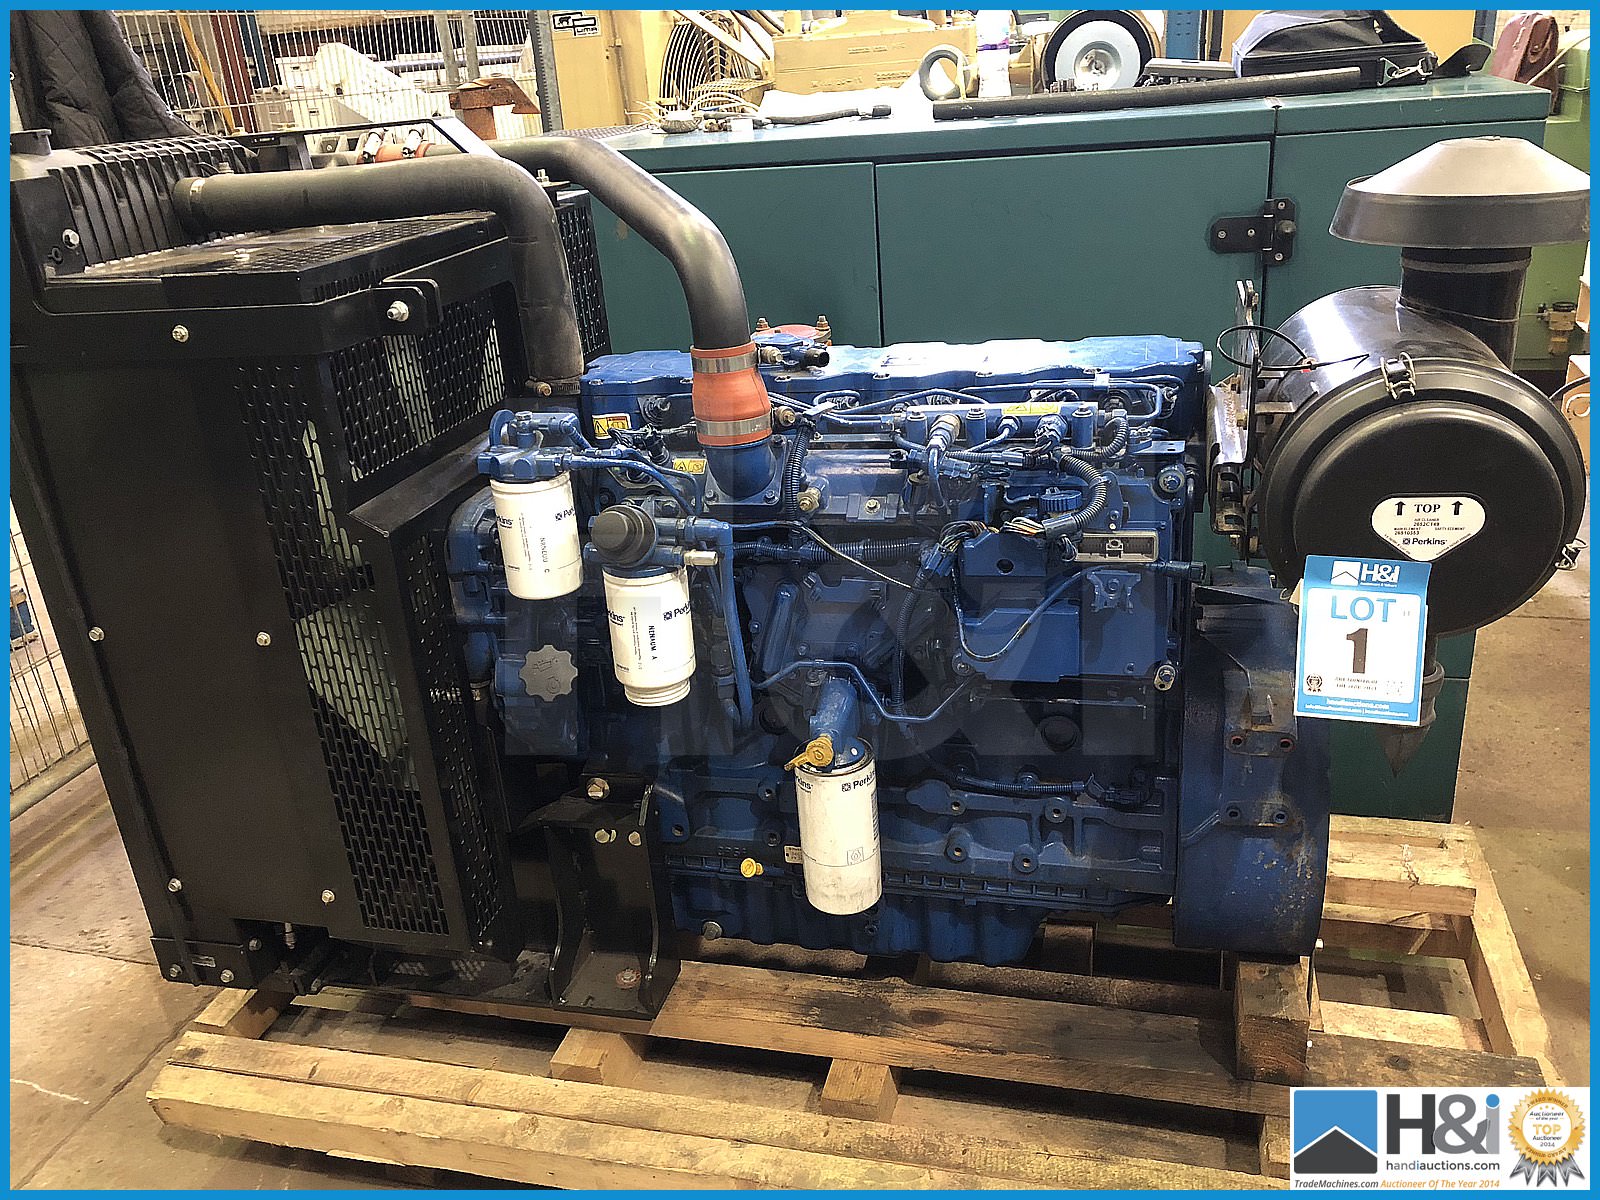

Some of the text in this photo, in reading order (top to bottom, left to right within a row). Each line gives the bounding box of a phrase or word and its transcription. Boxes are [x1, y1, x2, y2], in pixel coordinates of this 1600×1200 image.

[1414, 504, 1441, 513] TOP
[1412, 537, 1447, 546] Perkins
[1361, 563, 1400, 583] H&i
[1330, 595, 1397, 623] LOT
[1346, 628, 1369, 674] 1
